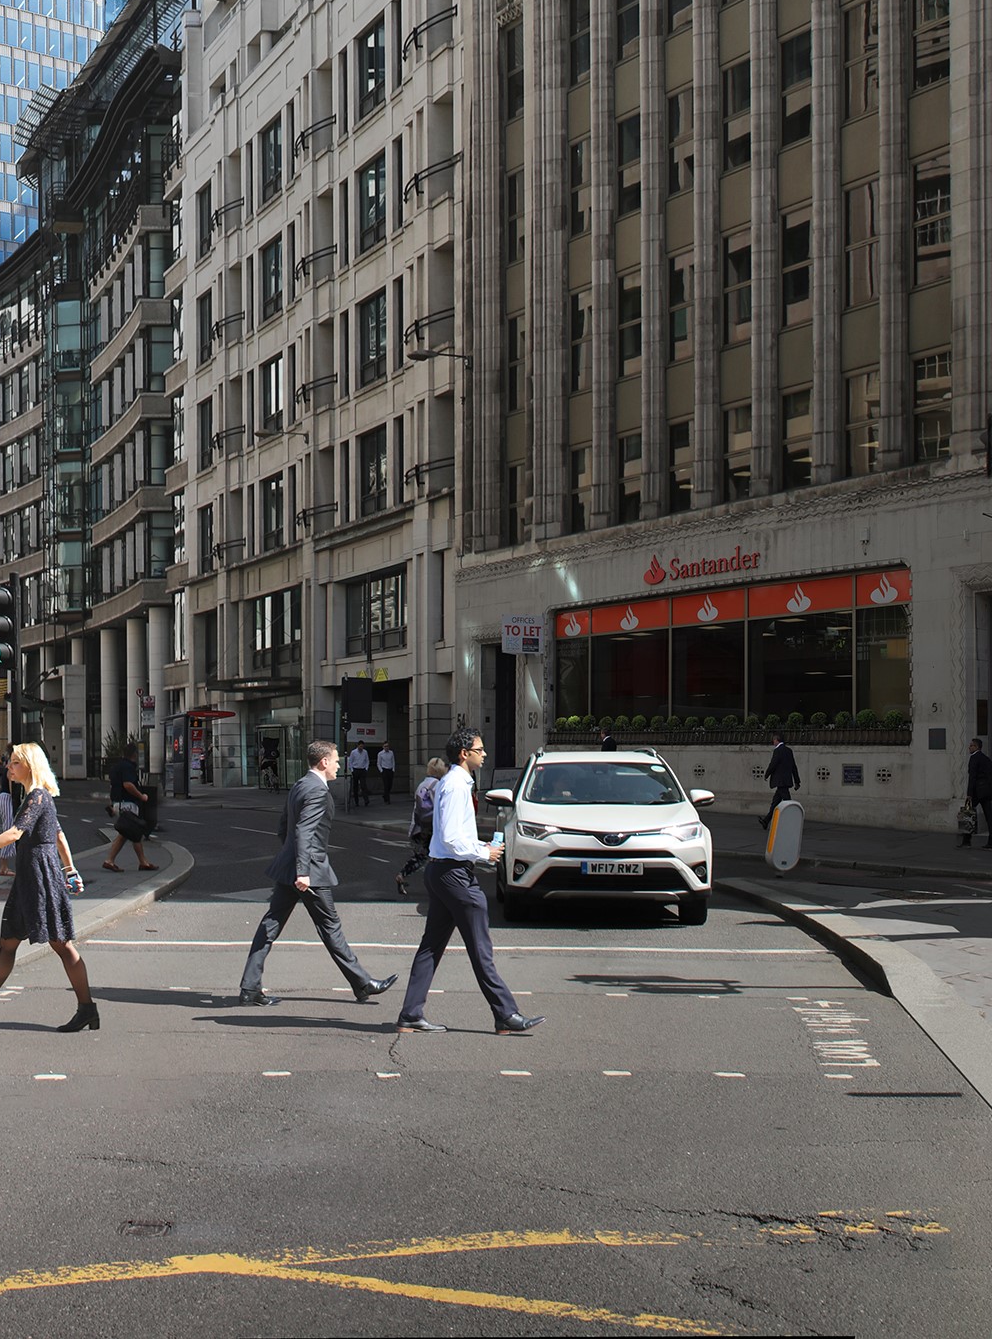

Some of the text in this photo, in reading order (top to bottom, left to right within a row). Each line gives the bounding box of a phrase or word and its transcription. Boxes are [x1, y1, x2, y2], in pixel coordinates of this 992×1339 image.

[669, 545, 760, 581] Santander
[511, 616, 535, 625] OFFICES
[504, 625, 542, 637] TO LET
[528, 711, 539, 729] 52
[590, 863, 639, 874] WF17 RWZ
